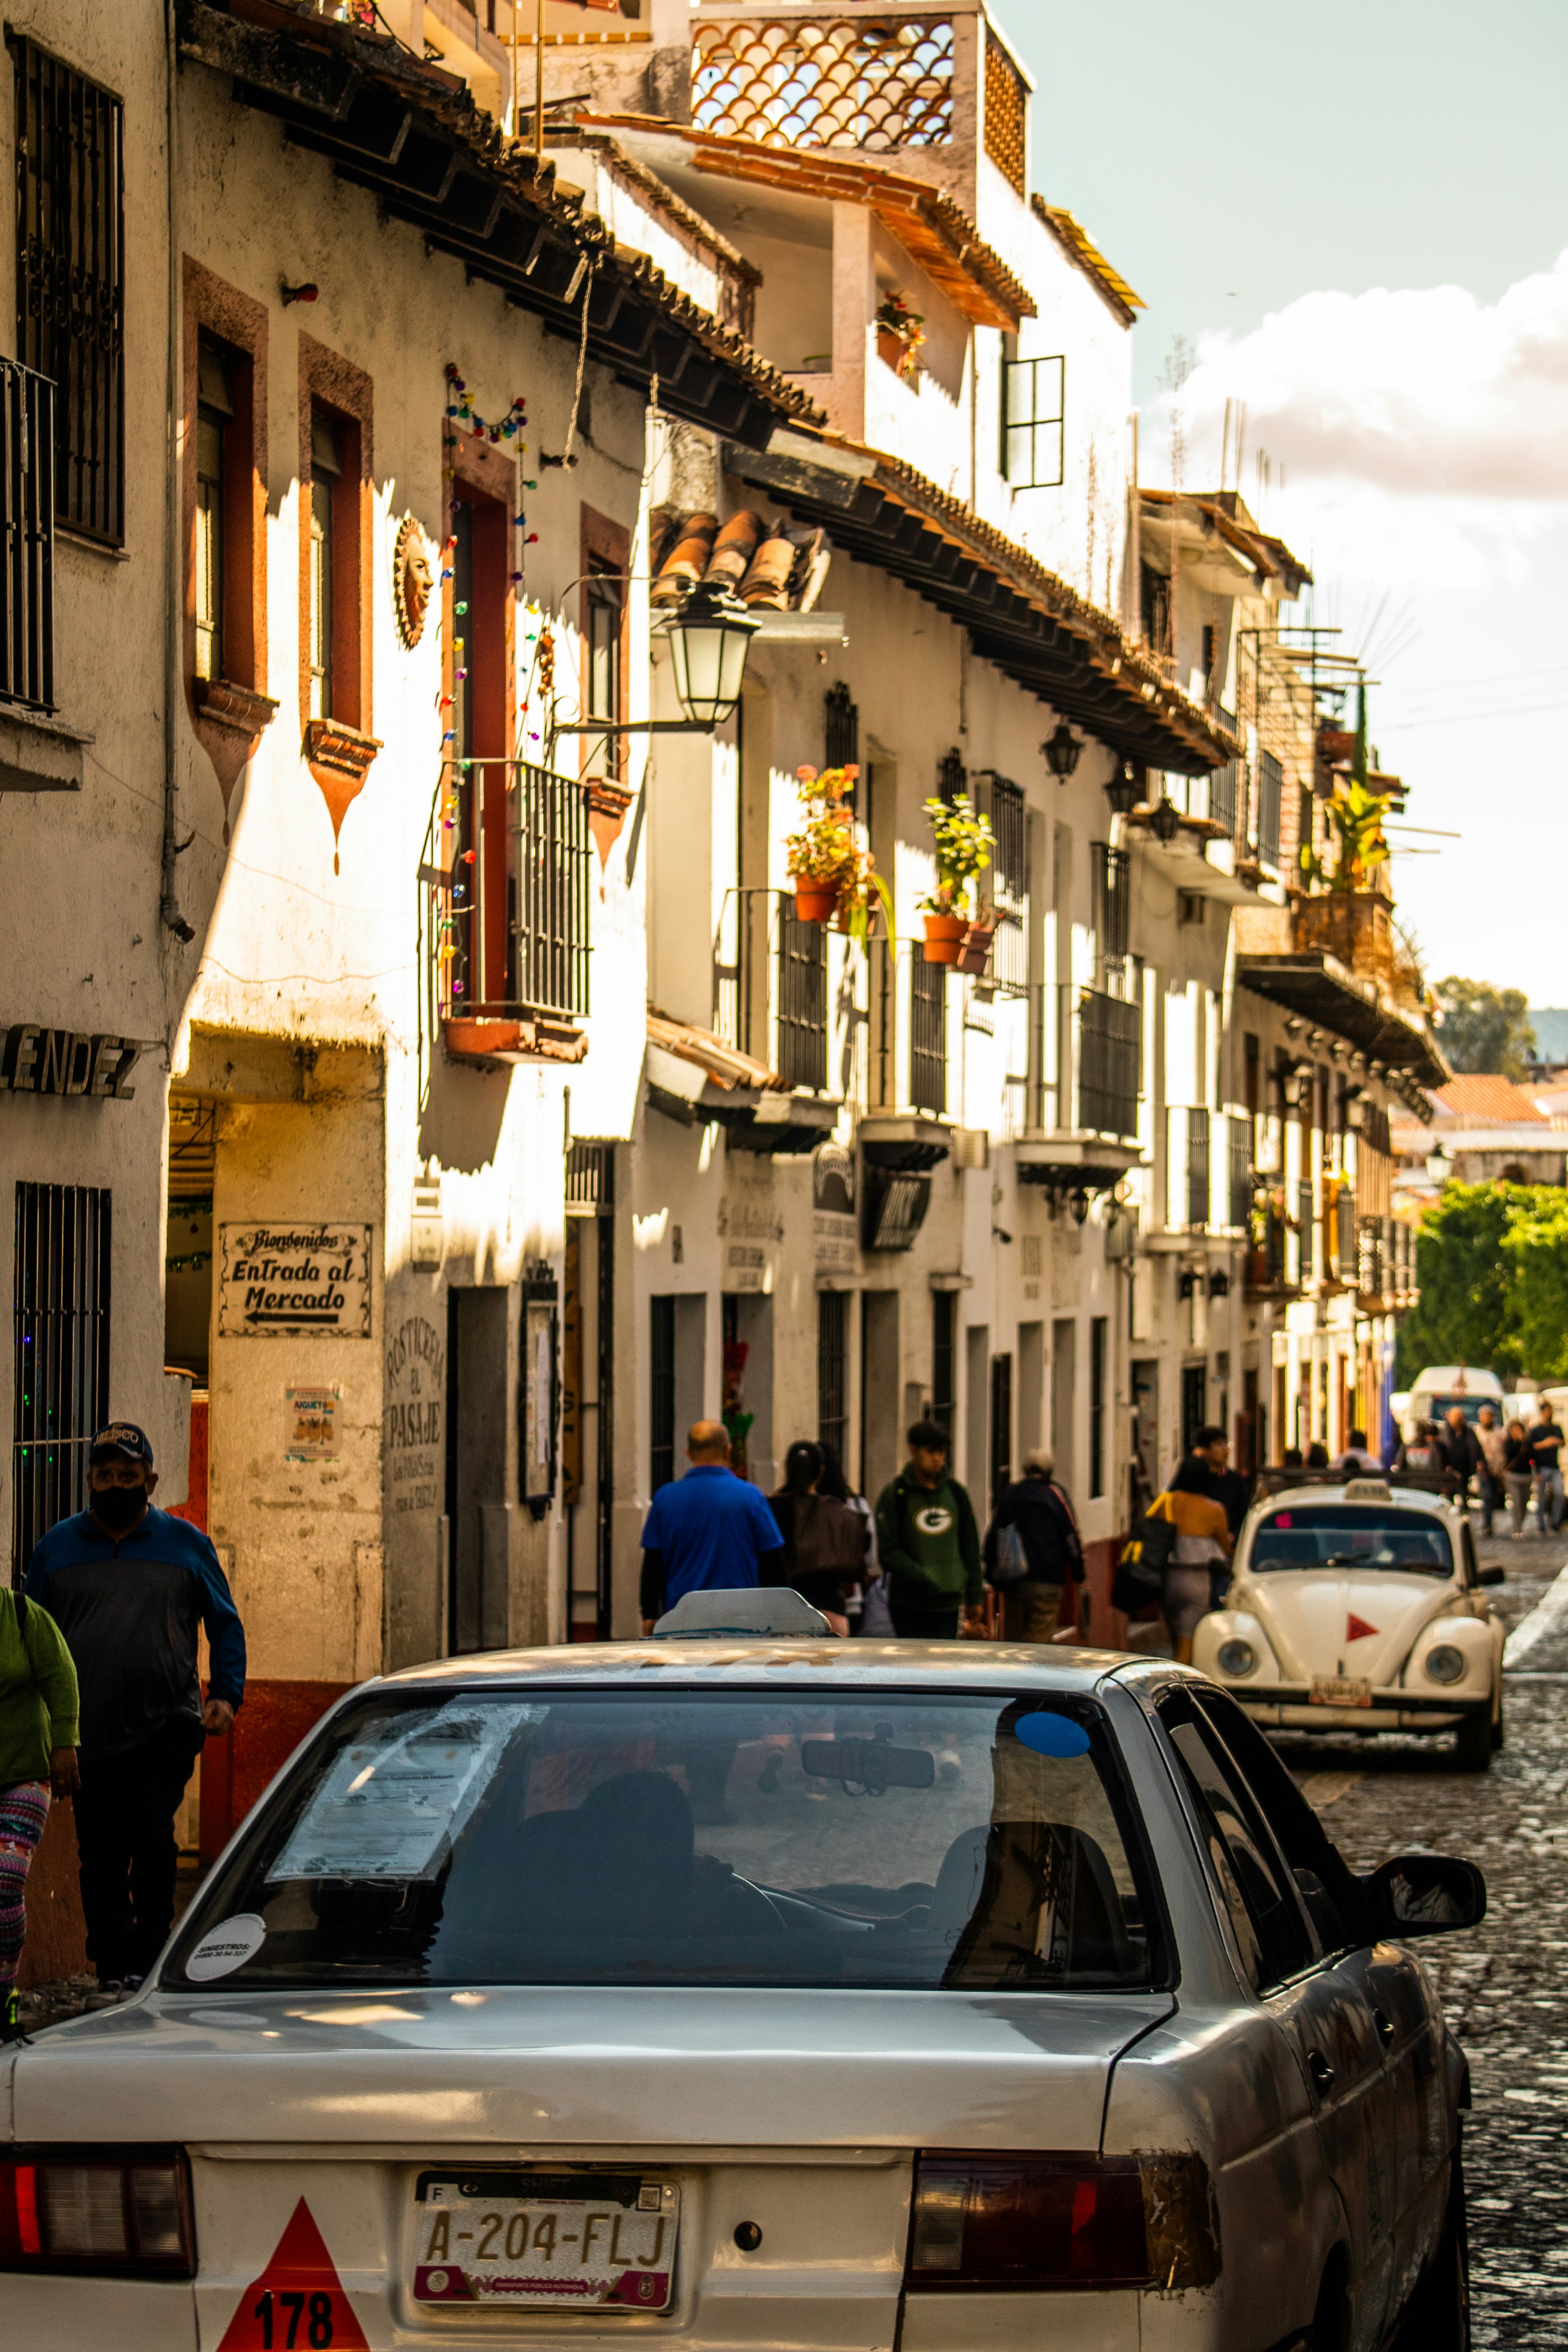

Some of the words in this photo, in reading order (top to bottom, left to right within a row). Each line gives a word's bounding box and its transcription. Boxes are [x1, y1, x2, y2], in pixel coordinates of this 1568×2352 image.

[328, 1258, 355, 1282] al
[244, 1283, 344, 1309] Mercado
[410, 1368, 421, 1395] EL
[389, 1401, 440, 1449] PASAJE
[433, 2188, 443, 2200] F
[426, 2211, 665, 2267] A-204-FLJ
[254, 2290, 333, 2350] 178
